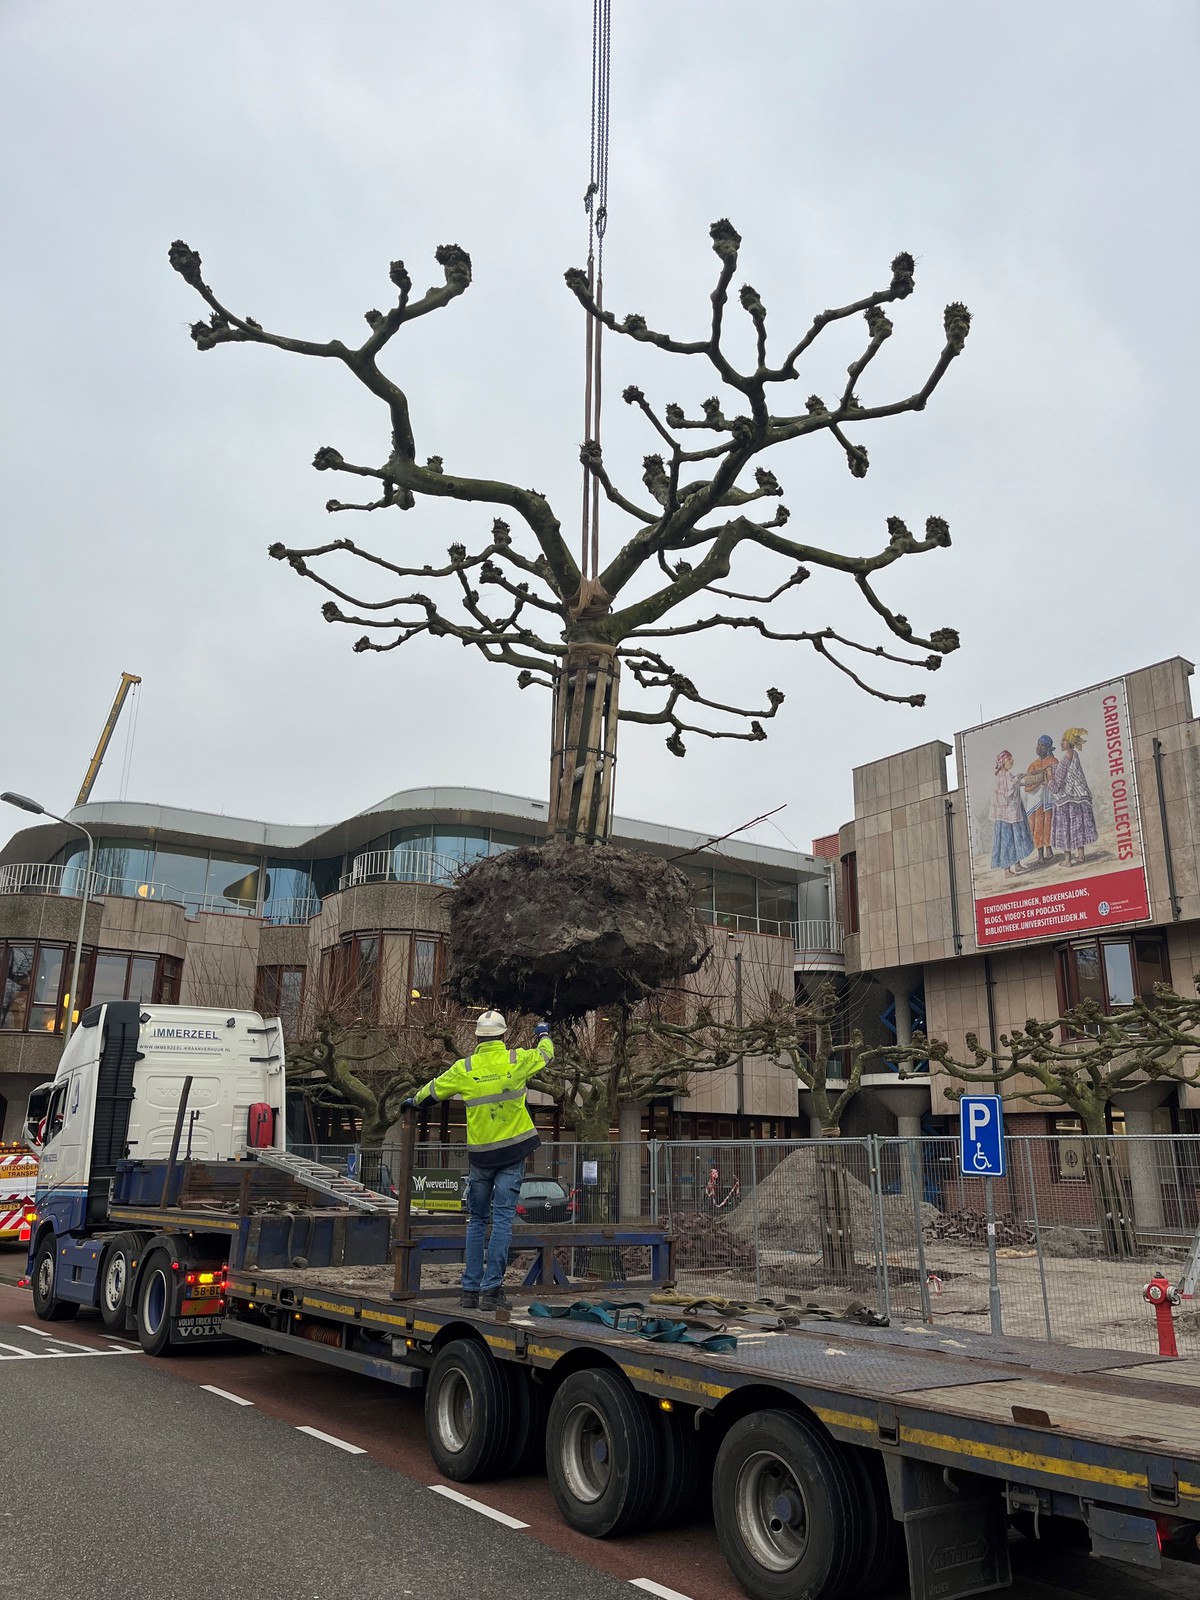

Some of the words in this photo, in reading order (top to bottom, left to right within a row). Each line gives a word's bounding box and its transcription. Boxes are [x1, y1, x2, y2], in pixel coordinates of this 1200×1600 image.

[1102, 695, 1125, 777] CARIBISCHE
[1111, 779, 1134, 861] COLLECTIES
[983, 897, 1042, 915] TENTOONSTELLINGEN,
[1042, 888, 1090, 904] BOEKENSALONS,
[984, 915, 1004, 925] BLOGS,
[1004, 910, 1026, 922] VIDEO'S
[1027, 909, 1035, 917] EN
[1035, 904, 1066, 916] PODCASTS
[985, 911, 1088, 936] BIBLIOTHEEK.UNIVERSITEITLEIDEN.NL
[153, 1028, 219, 1039] IMMERZEEL
[155, 1087, 211, 1097] VOVO
[969, 1103, 991, 1141] P
[425, 1178, 459, 1191] weverling
[178, 1318, 195, 1327] VOLVO
[195, 1316, 212, 1326] TRUCK
